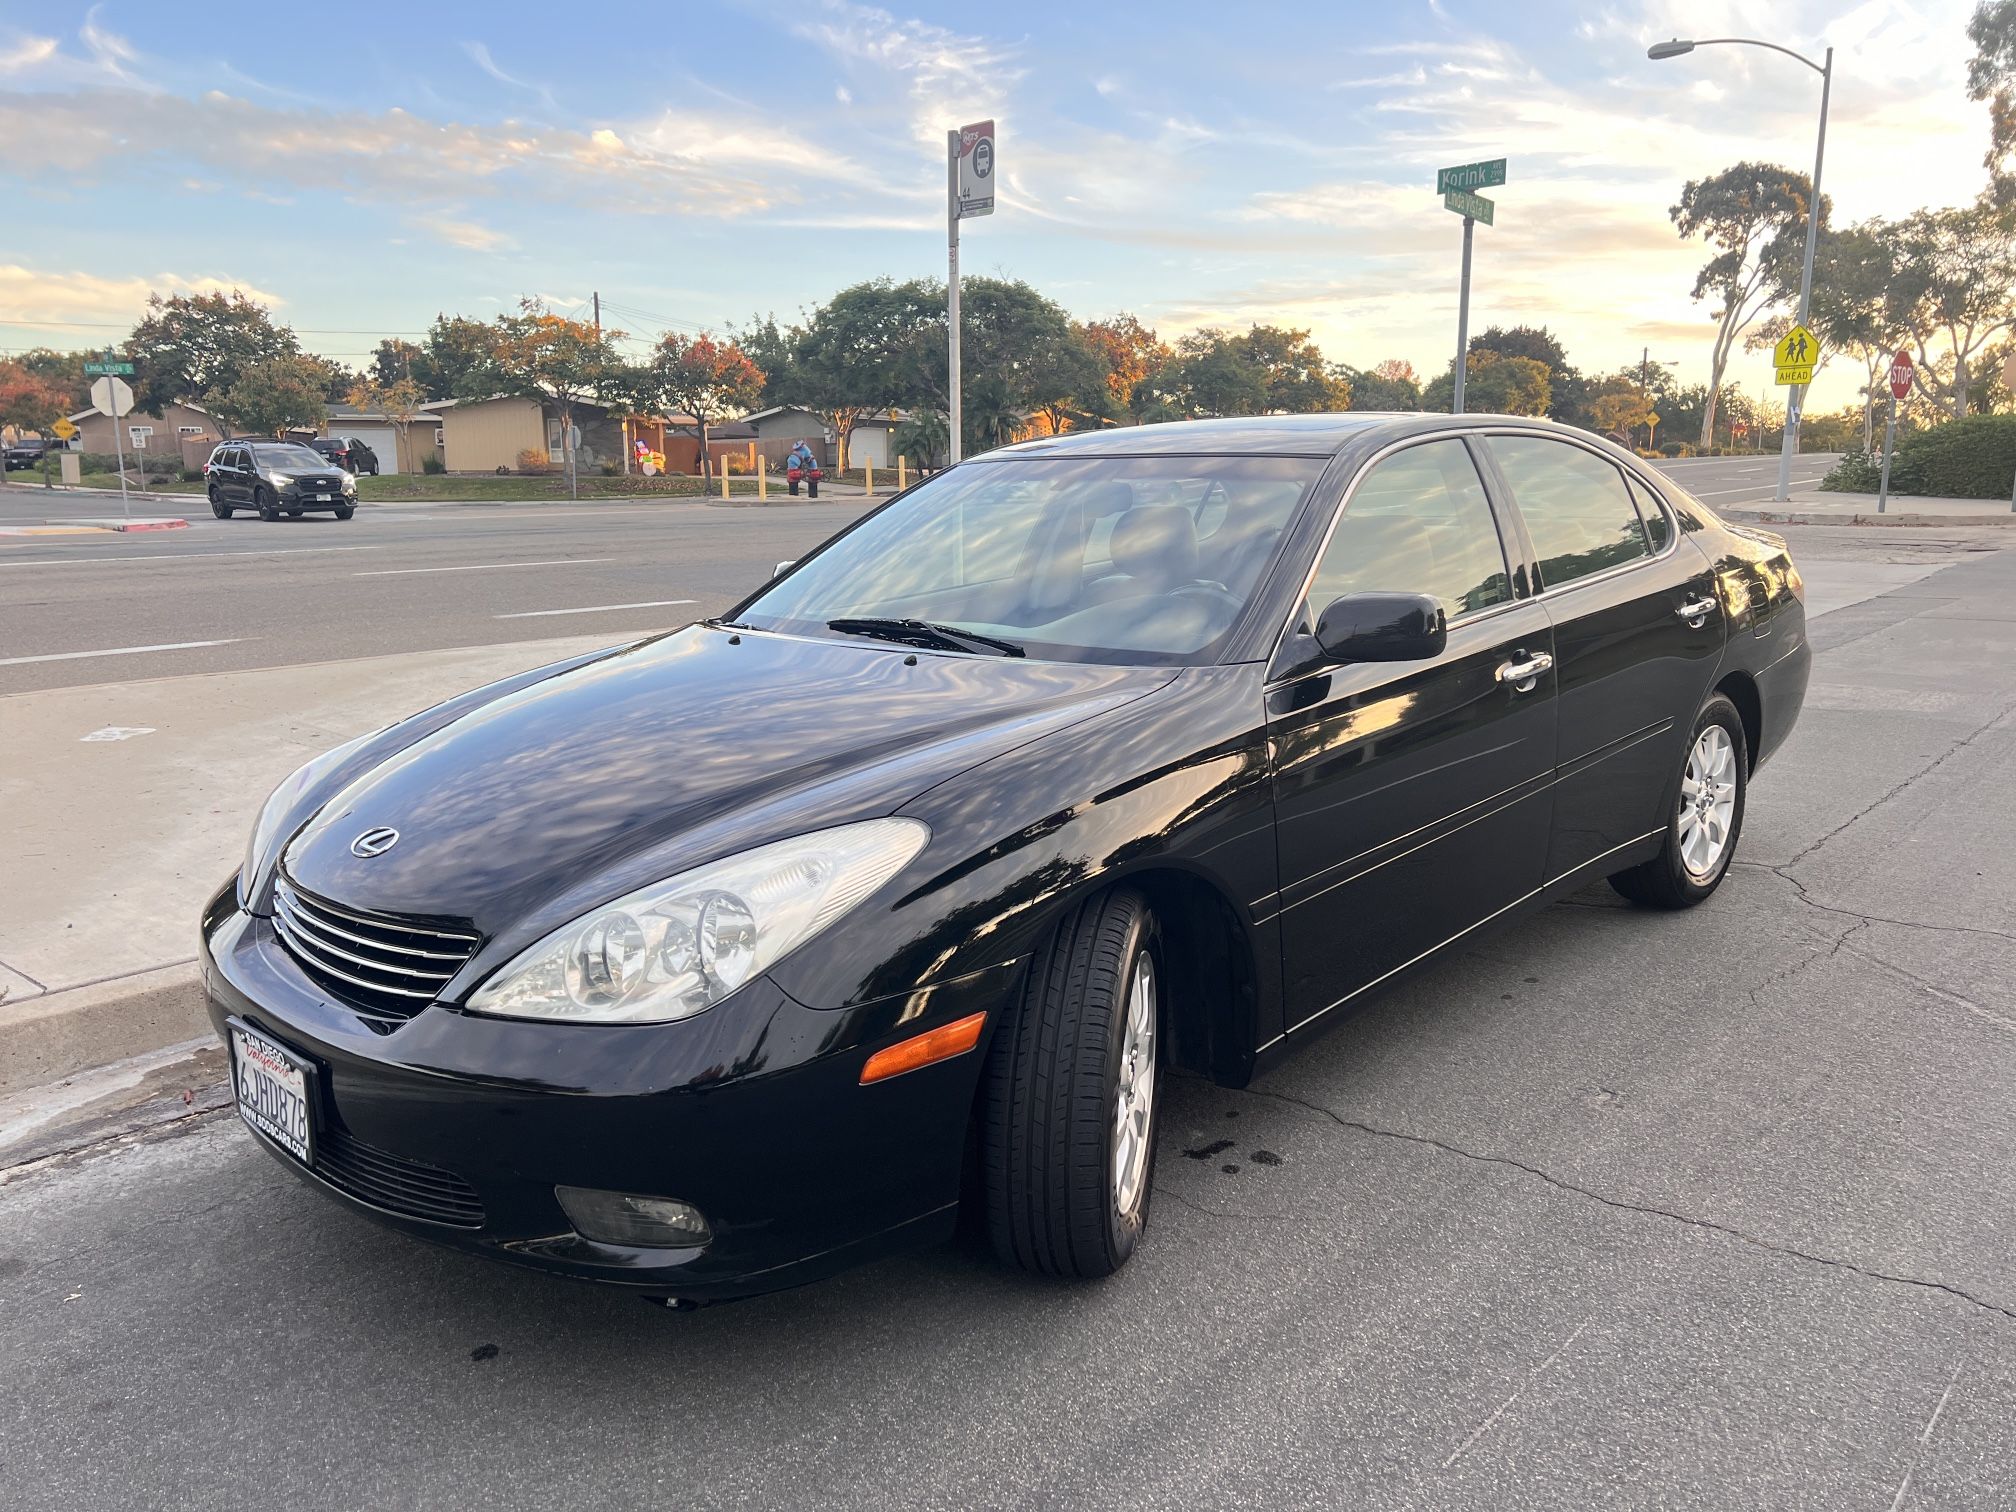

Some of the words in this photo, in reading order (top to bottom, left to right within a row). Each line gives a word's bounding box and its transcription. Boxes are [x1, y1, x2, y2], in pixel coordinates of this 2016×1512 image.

[1442, 166, 1485, 189] Korink
[84, 363, 103, 372] Linda
[104, 363, 122, 372] Vista
[1779, 371, 1808, 381] AHEAD
[1892, 365, 1912, 385] STOP
[245, 1032, 261, 1052] SAN
[261, 1041, 285, 1066] DIEGO
[240, 1062, 307, 1143] 6JHD878
